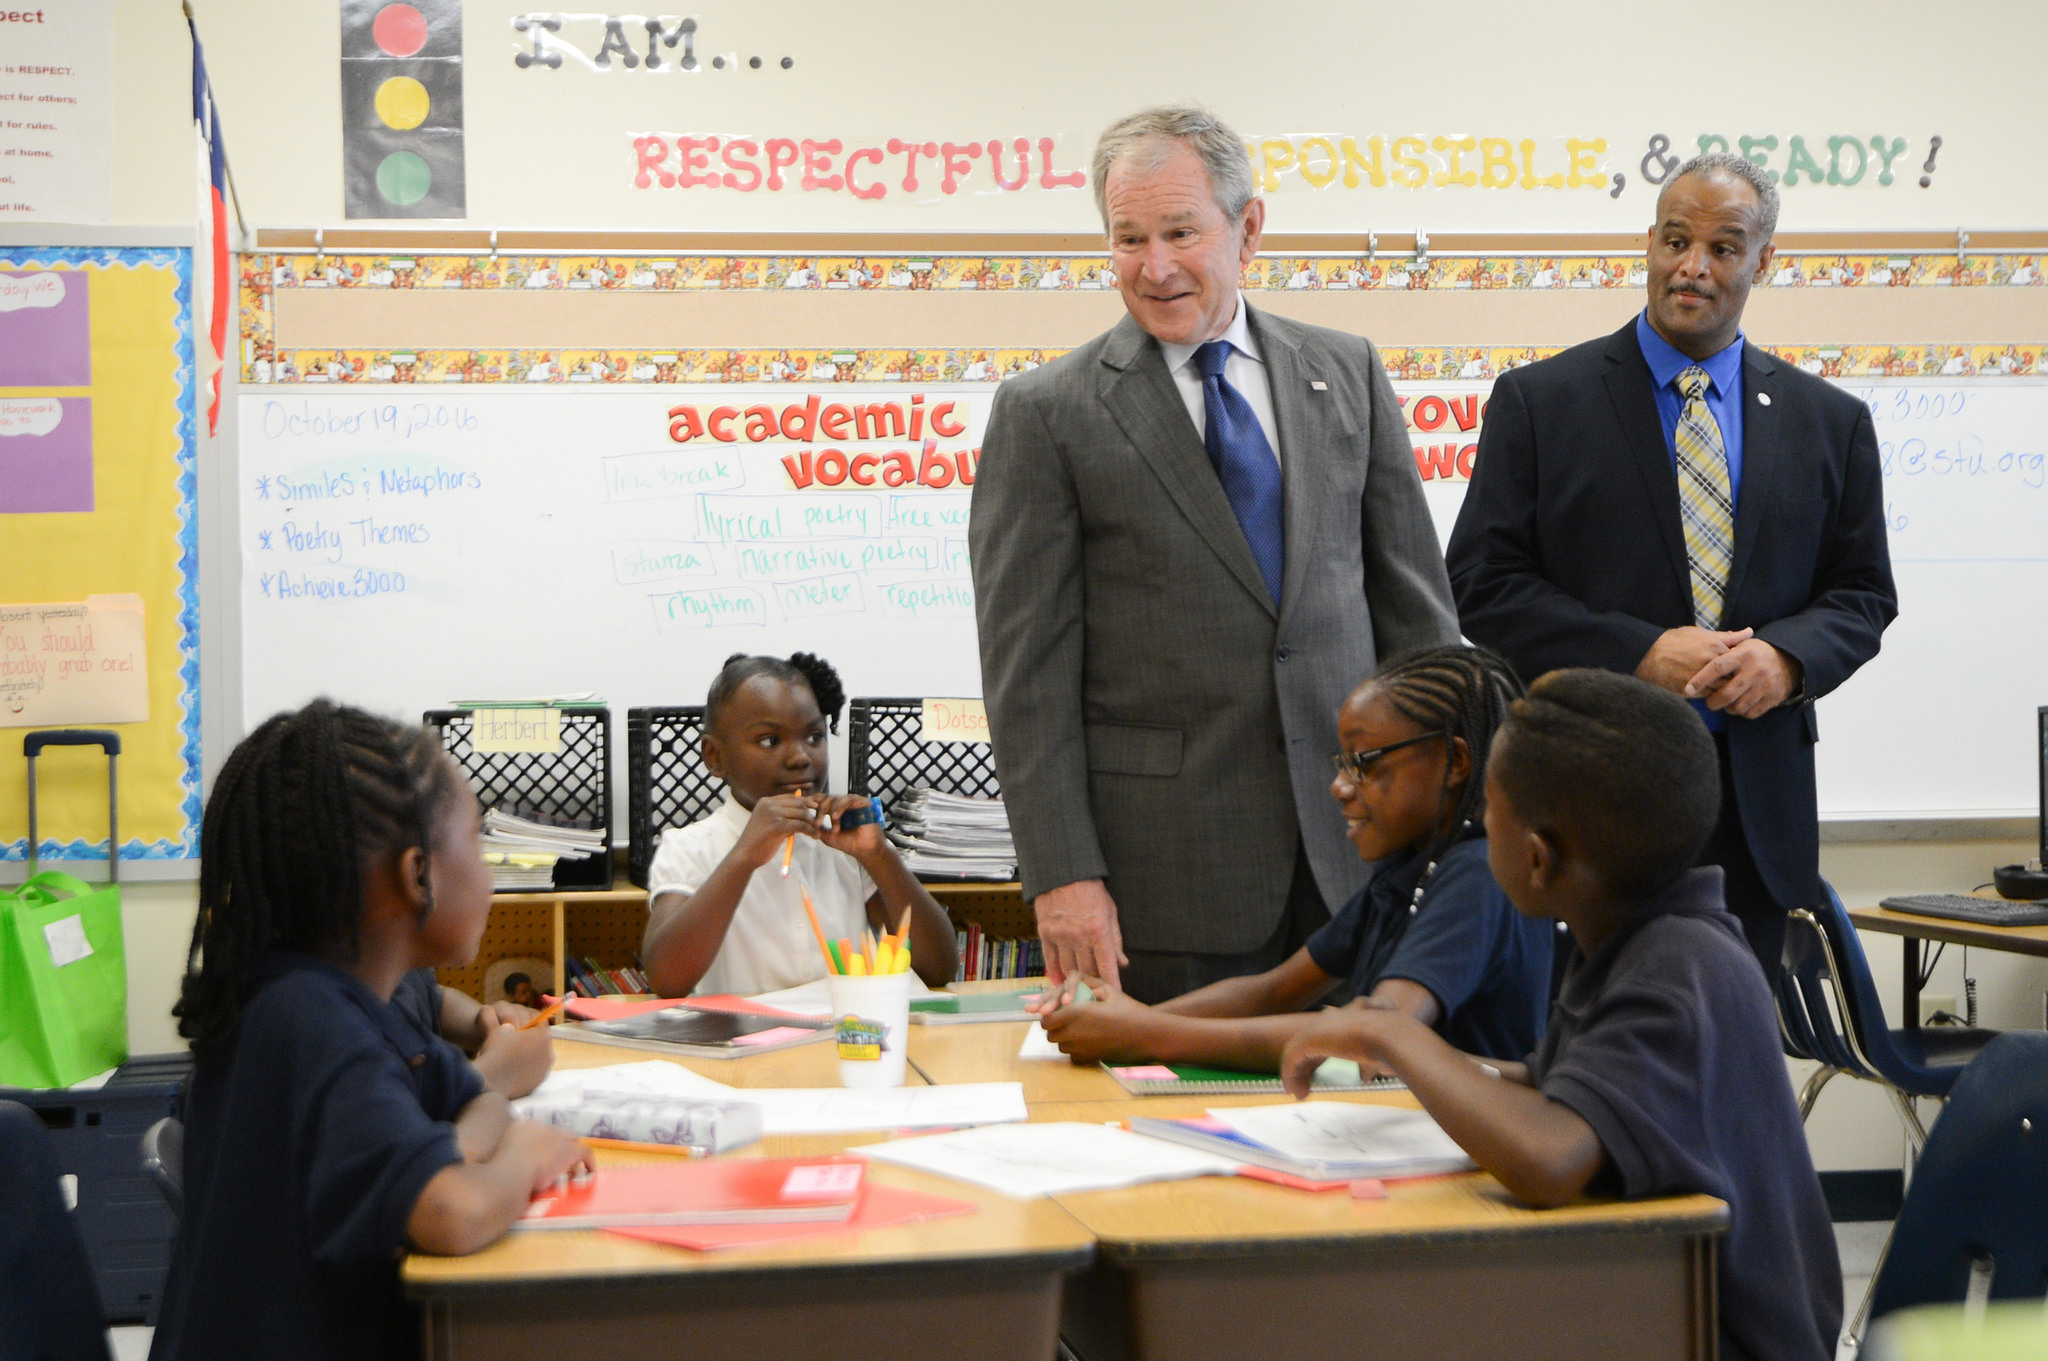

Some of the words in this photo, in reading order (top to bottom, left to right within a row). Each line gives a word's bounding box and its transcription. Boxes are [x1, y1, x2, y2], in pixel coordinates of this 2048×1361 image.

[514, 15, 562, 69] I
[19, 65, 76, 76] RESPECT.
[19, 93, 35, 102] for
[7, 120, 22, 129] for
[5, 148, 16, 156] at
[633, 136, 1087, 199] RESPECTFUL
[1247, 135, 1626, 200] PONSIBLE,
[1641, 133, 1681, 186] &
[14, 202, 36, 213] life.
[263, 400, 367, 439] October
[668, 393, 967, 443] academic
[1892, 387, 1967, 423] 3000
[702, 494, 782, 549] lyrical
[804, 502, 868, 534] poetry
[889, 495, 934, 528] free
[282, 520, 344, 563] Poetry
[349, 517, 431, 546] Themes
[742, 545, 853, 575] narrative
[861, 538, 929, 574] poetry
[623, 549, 701, 576] stanza
[668, 589, 756, 629] rhythm
[786, 577, 852, 608] meter
[58, 652, 94, 680] grab
[479, 708, 549, 741] Herbert
